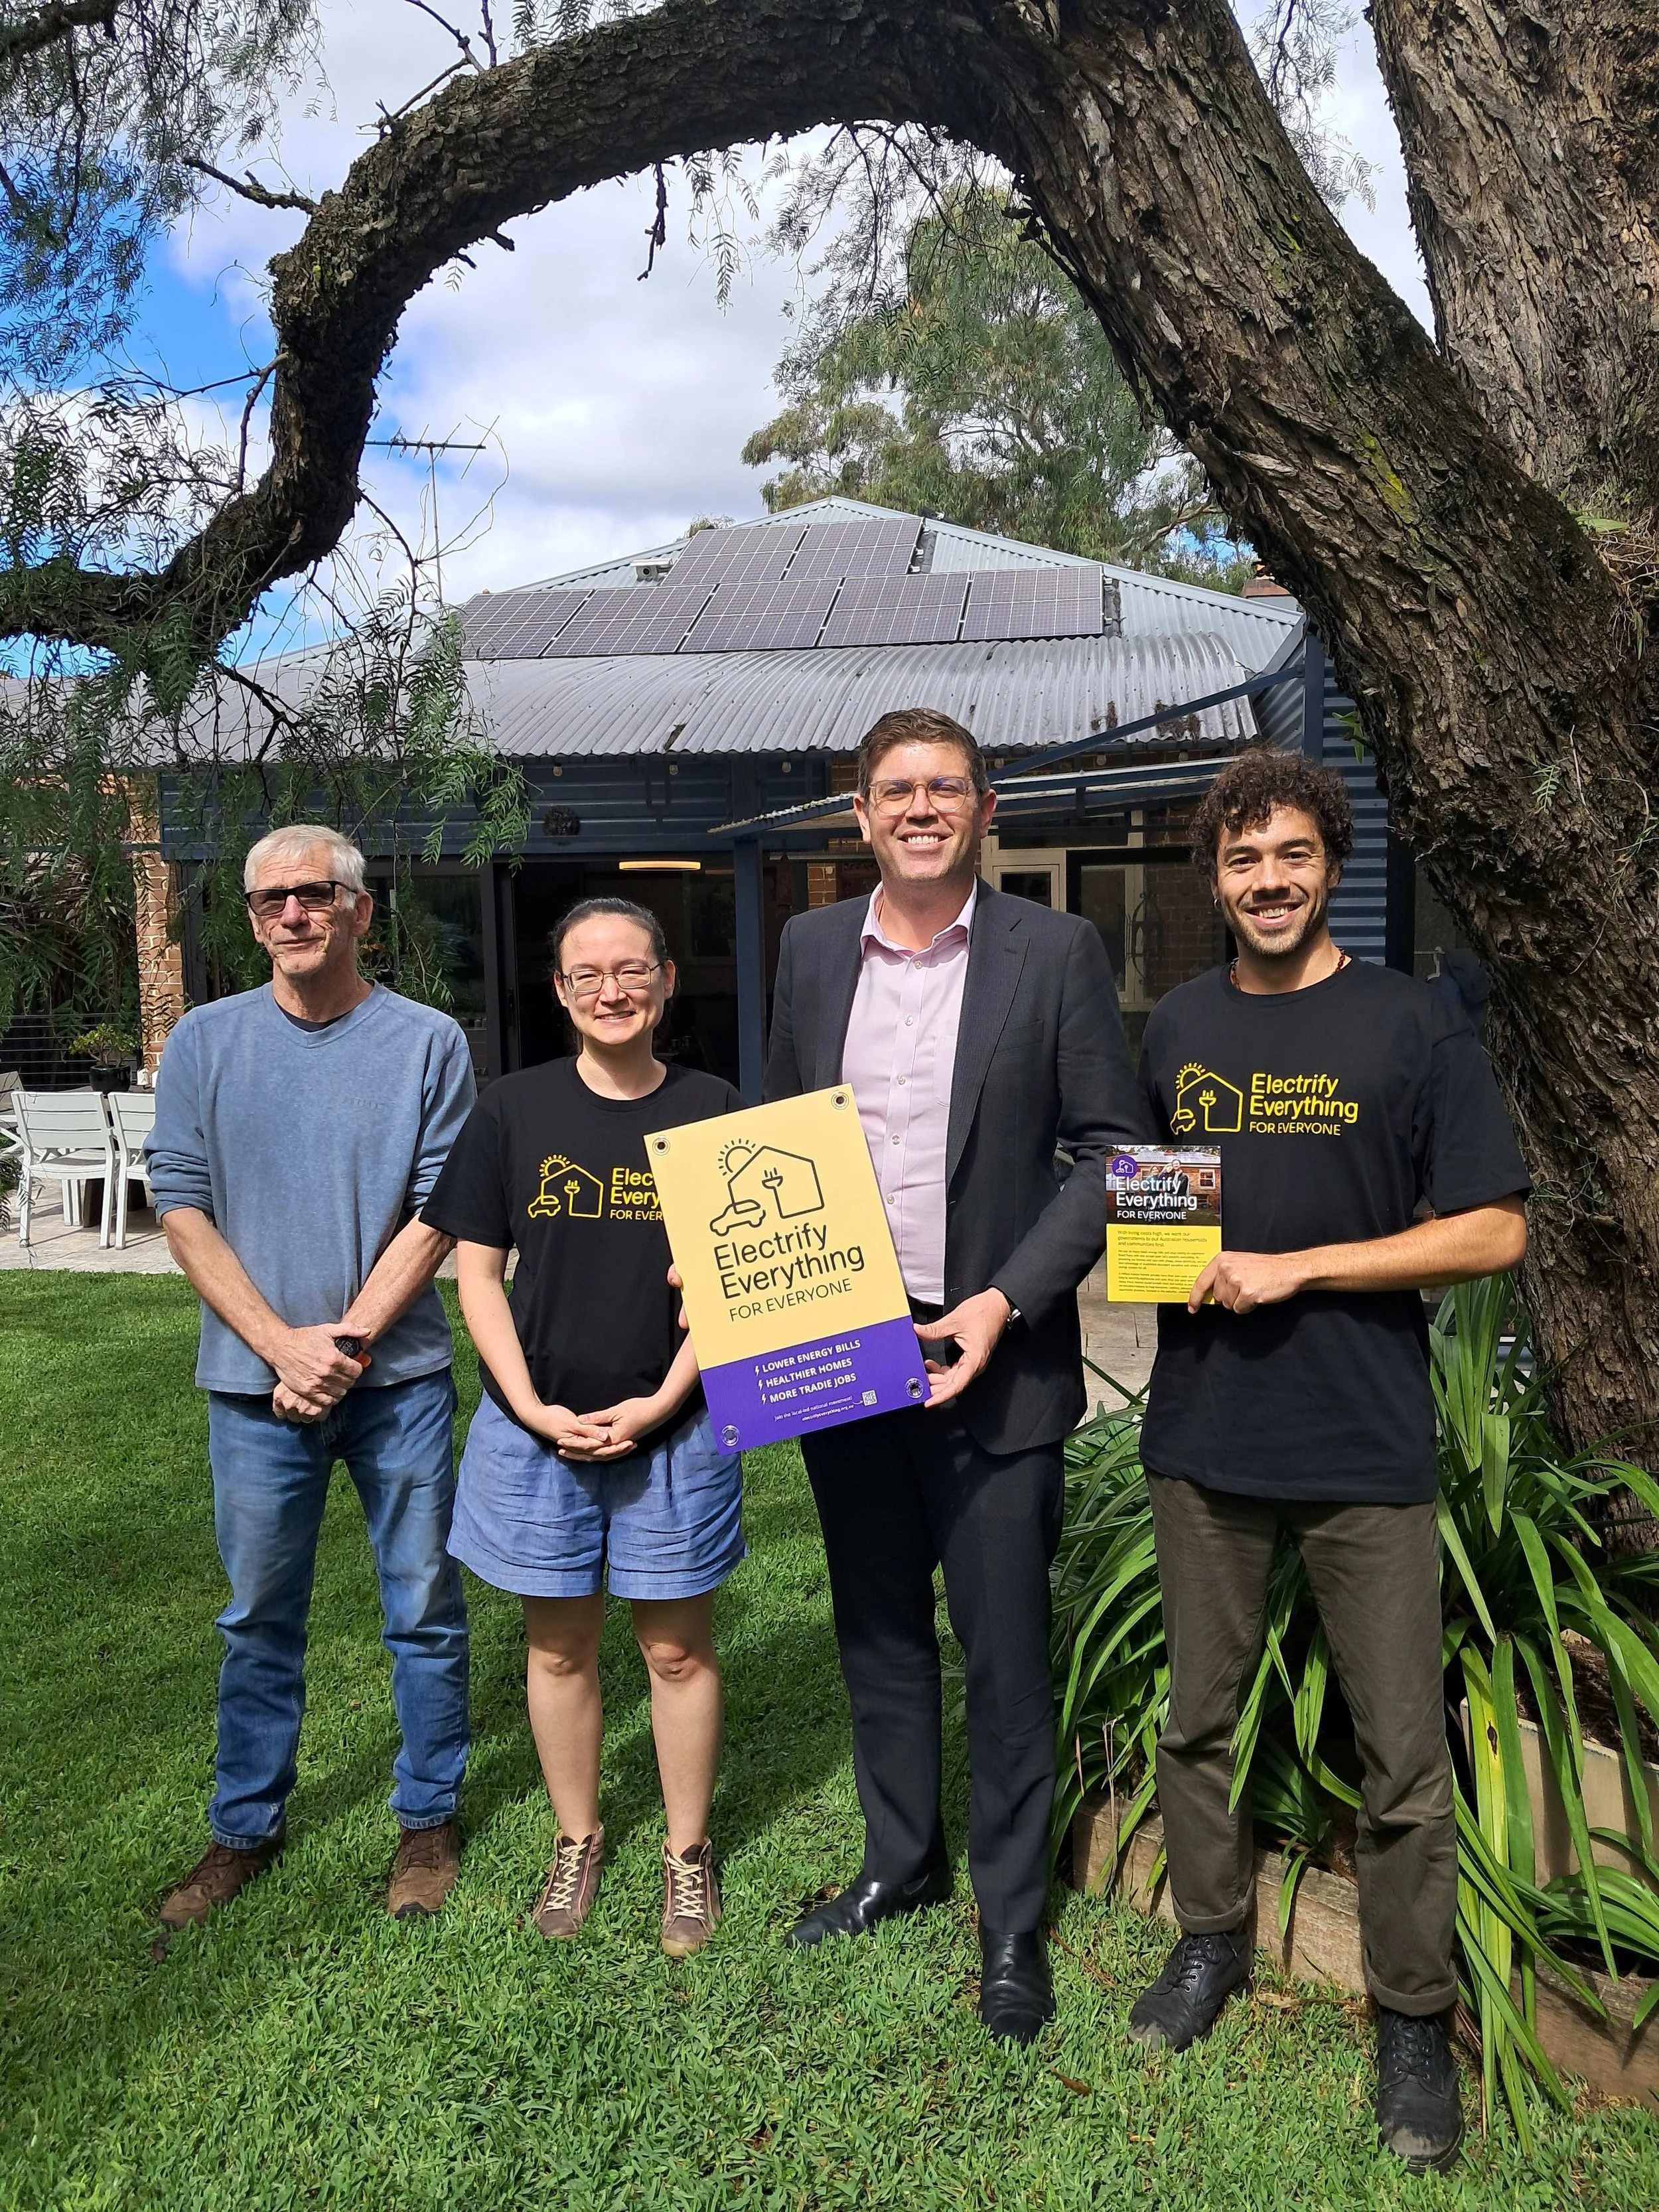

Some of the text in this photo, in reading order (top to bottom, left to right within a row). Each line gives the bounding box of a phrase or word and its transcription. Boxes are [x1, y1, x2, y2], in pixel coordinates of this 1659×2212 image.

[1251, 1072, 1339, 1098] Electrify
[1250, 1094, 1359, 1124] Everything
[1249, 1122, 1341, 1136] FOR EVERYONE
[1116, 1176, 1182, 1195] Electrify
[610, 1209, 633, 1220] FOR
[1116, 1192, 1198, 1211] Everything
[1117, 1211, 1187, 1220] FOR EVERYONE
[713, 1222, 827, 1271] Electrify
[721, 1245, 865, 1299] Everything
[729, 1278, 853, 1322] FOR EVERYONE
[762, 1339, 861, 1373] LOWER ENERGY BILLS
[766, 1358, 853, 1388] HEALTHIER HOMES
[769, 1372, 857, 1403] MORE TRADIE JOBS
[810, 1402, 828, 1412] national
